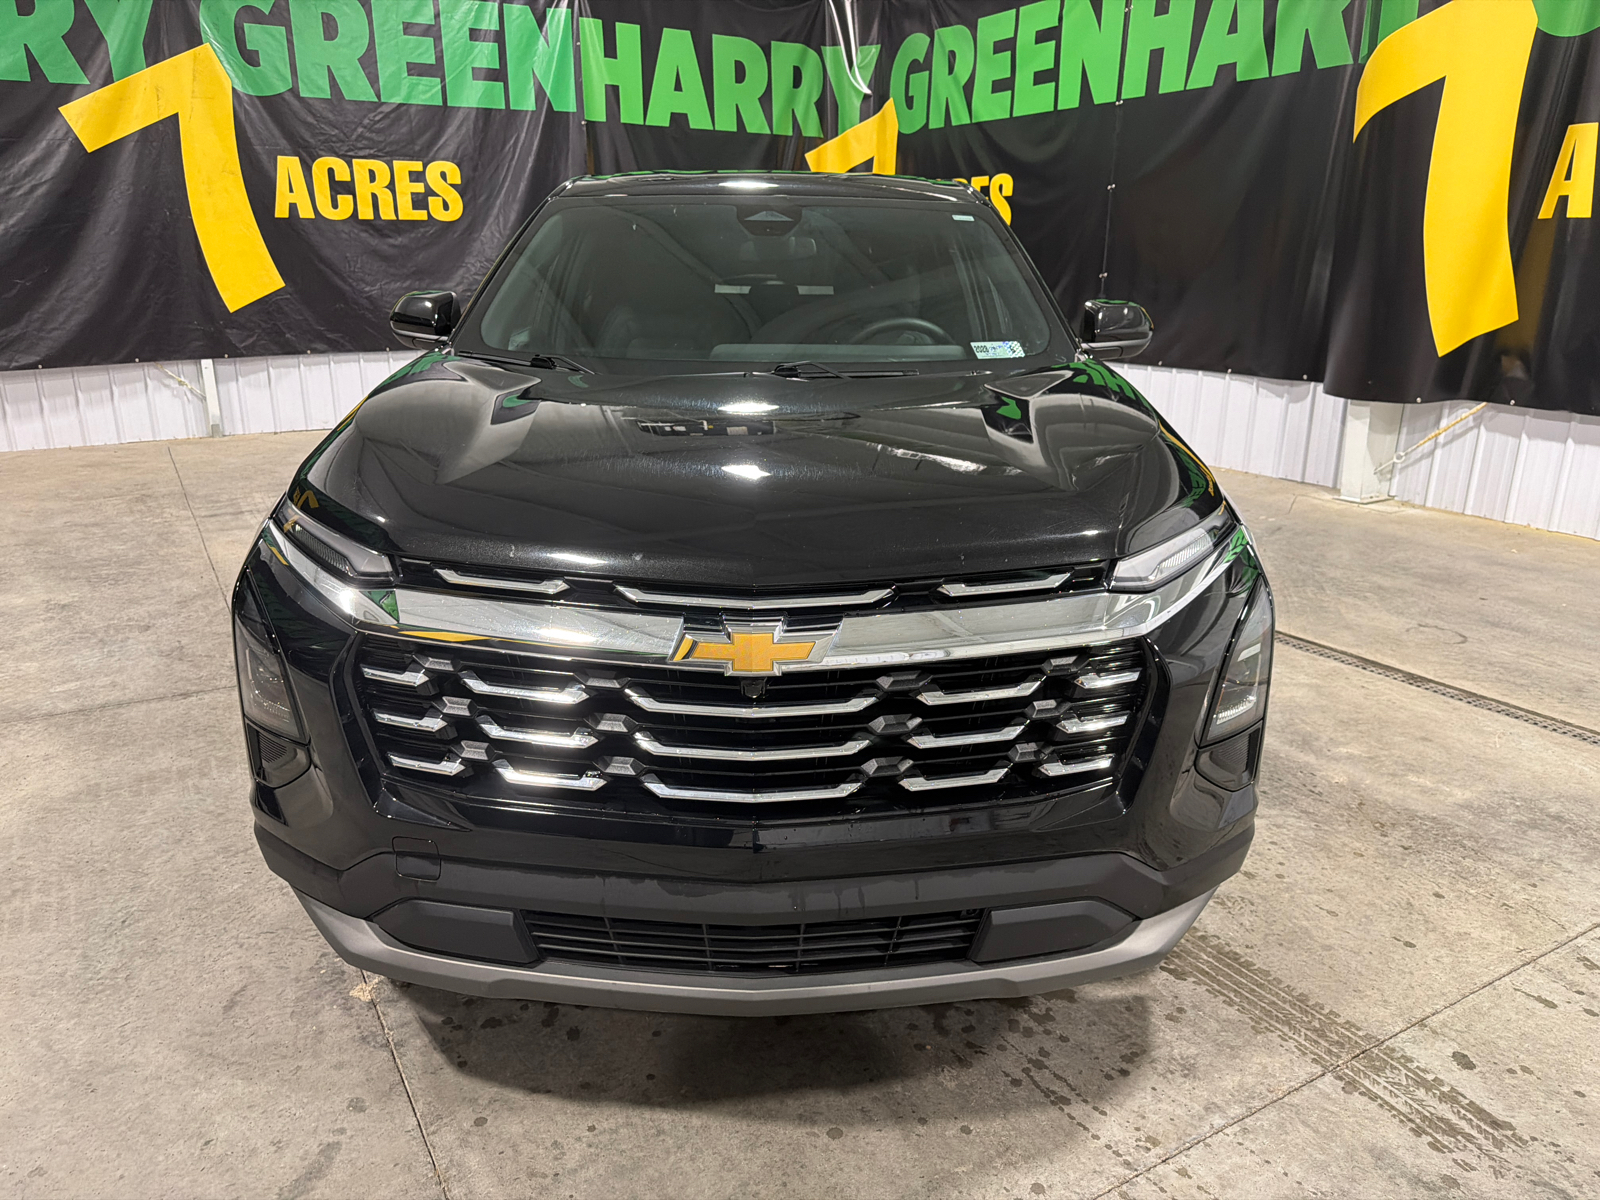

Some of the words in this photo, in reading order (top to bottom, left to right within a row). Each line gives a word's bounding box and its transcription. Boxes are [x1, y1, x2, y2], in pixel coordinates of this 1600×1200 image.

[200, 0, 577, 112] GREEN
[579, 17, 881, 138] HARRY
[890, 0, 1126, 134] GREEN
[58, 42, 285, 313] 7
[274, 155, 464, 222] ACRES
[1353, 0, 1538, 357] 7
